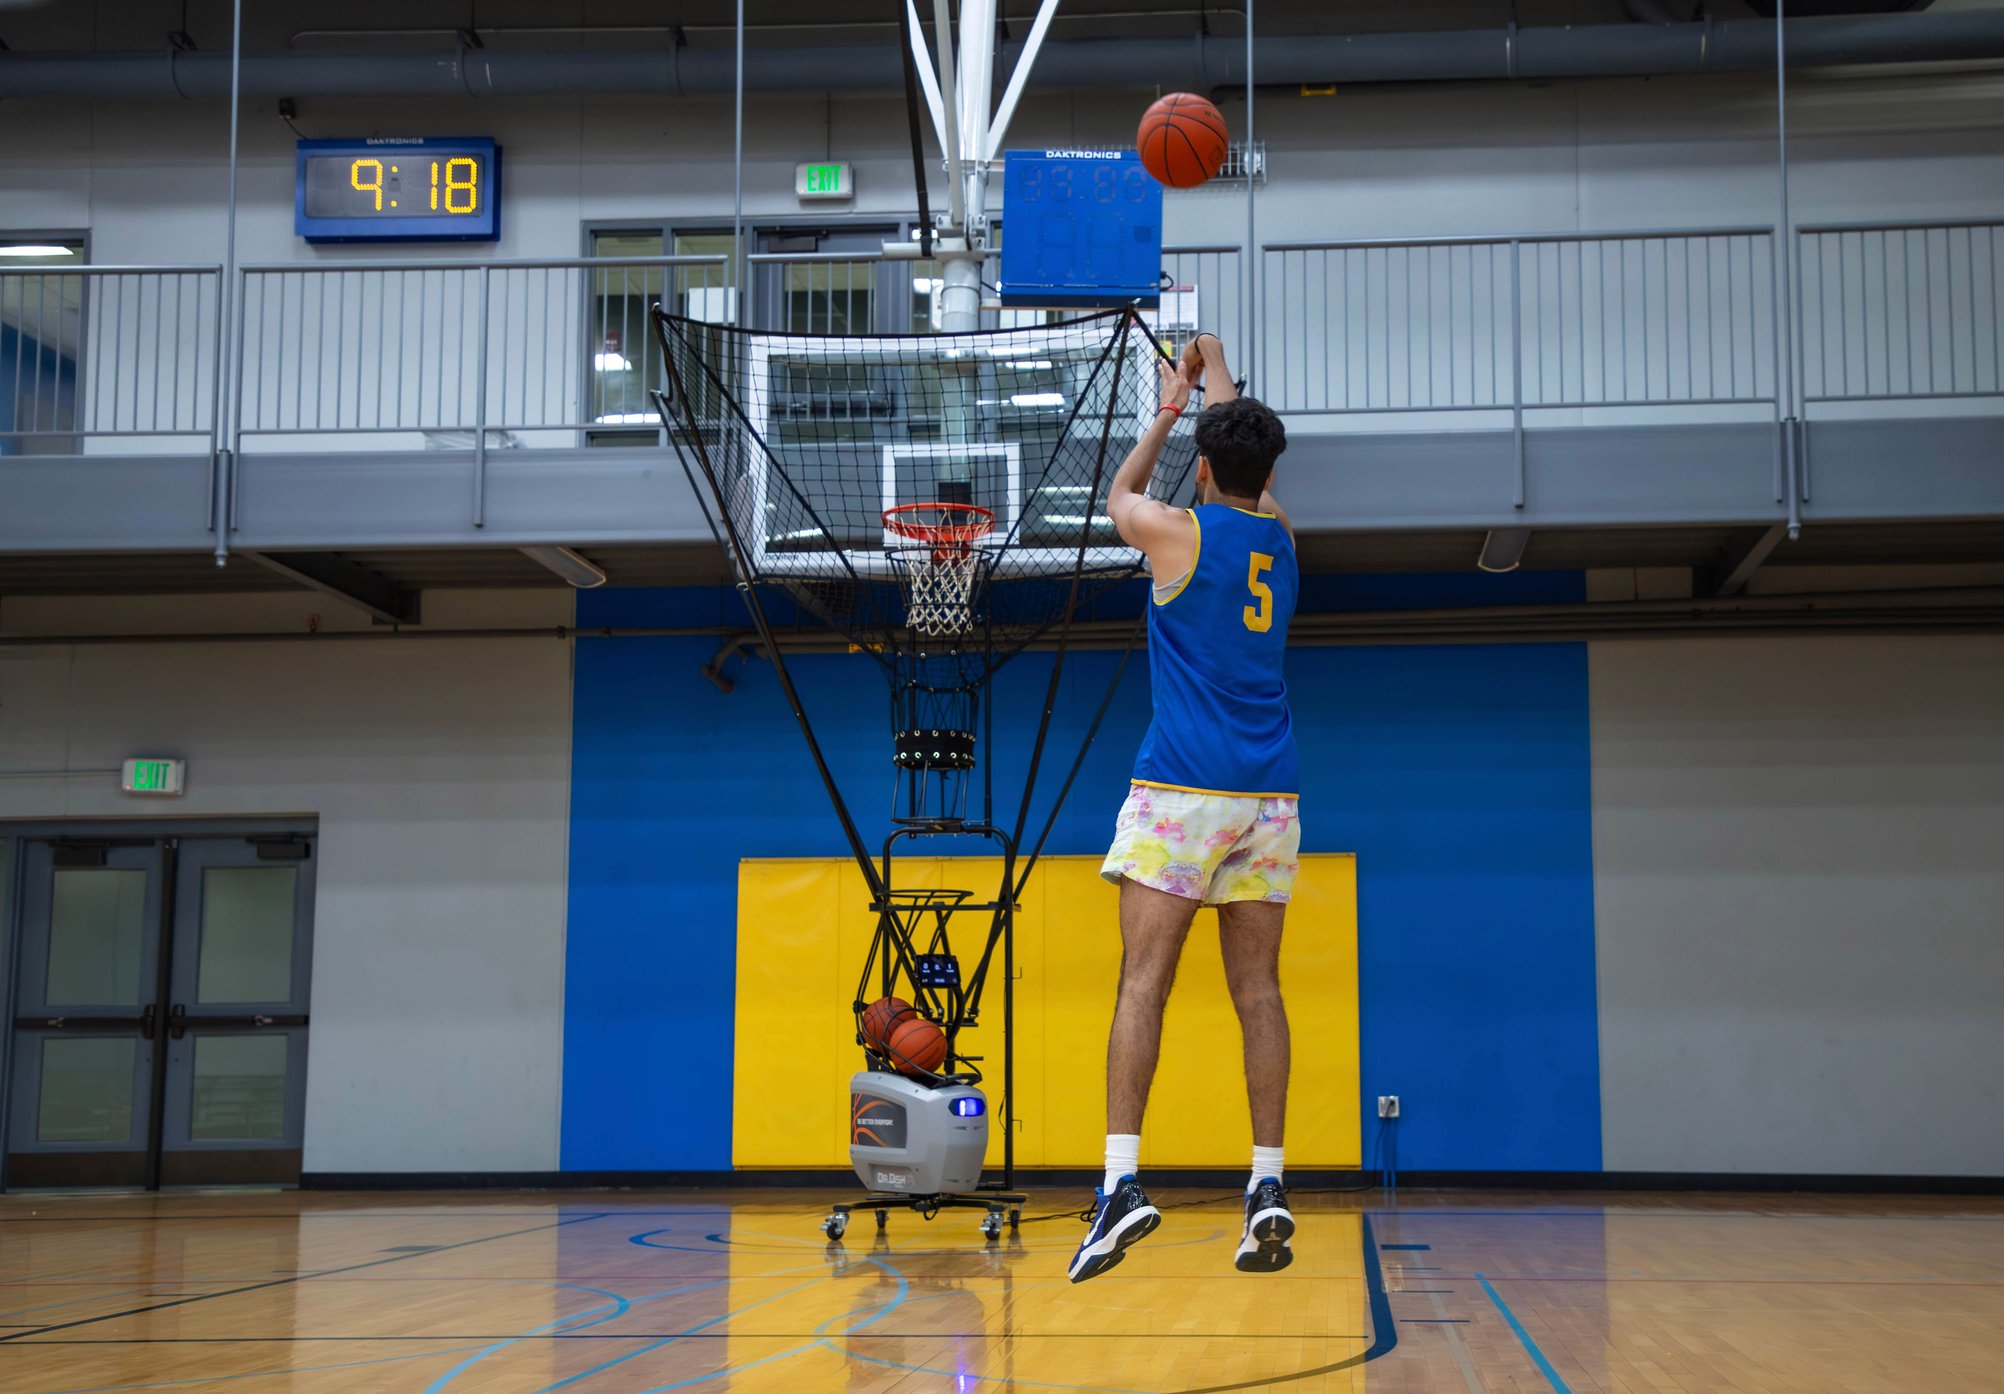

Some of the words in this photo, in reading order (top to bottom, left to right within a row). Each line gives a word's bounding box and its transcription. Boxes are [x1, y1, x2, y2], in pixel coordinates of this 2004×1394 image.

[366, 137, 424, 145] DAKTRONICS
[1045, 150, 1122, 159] DAKTRONICS
[351, 157, 478, 213] 9:18
[807, 165, 841, 192] EXIT
[1243, 551, 1275, 633] 5
[134, 761, 170, 790] EXIT
